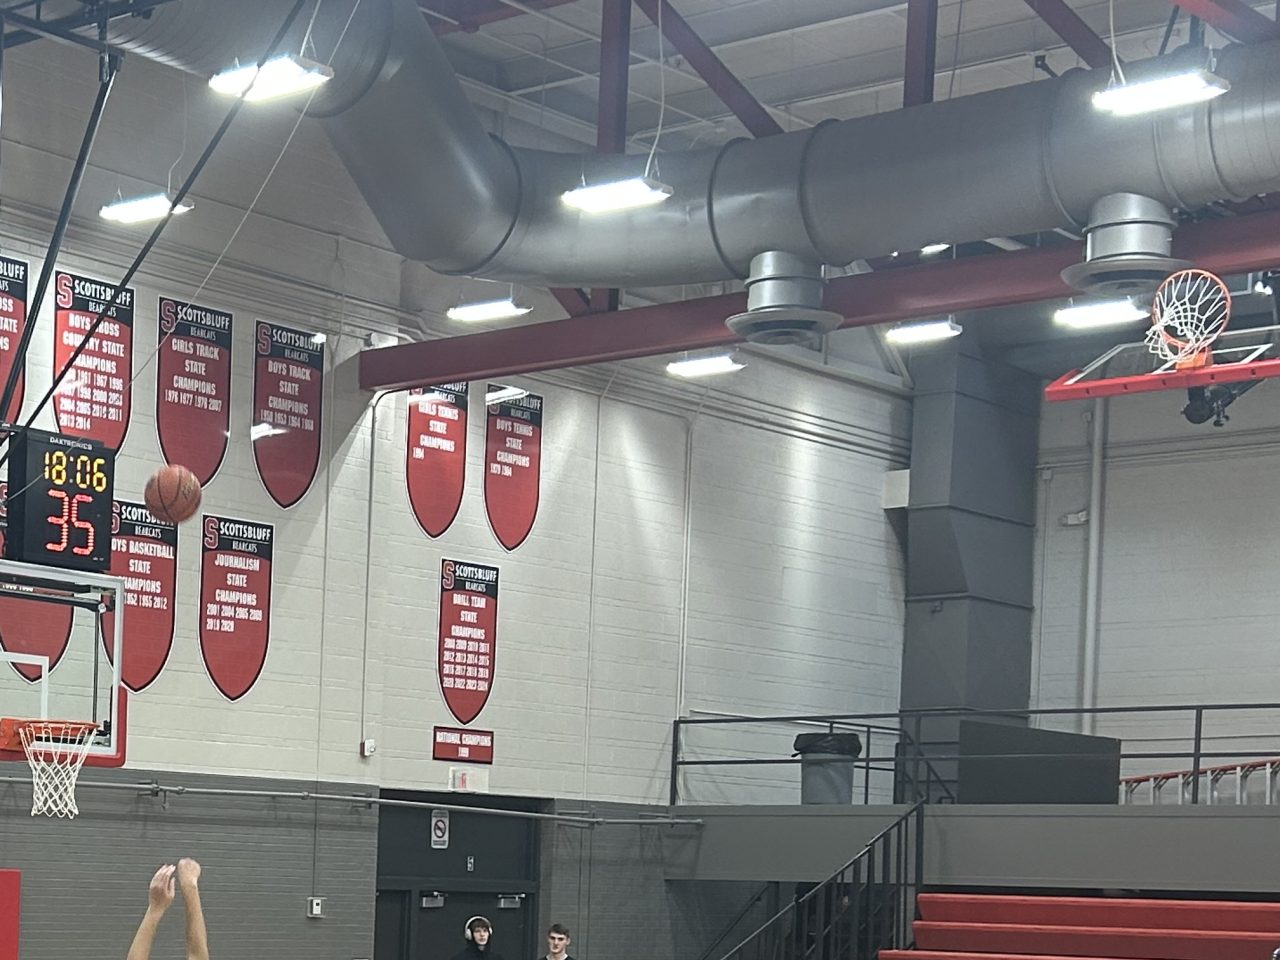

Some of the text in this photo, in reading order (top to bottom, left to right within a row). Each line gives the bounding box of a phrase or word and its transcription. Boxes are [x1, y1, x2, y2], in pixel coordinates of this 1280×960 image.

[68, 312, 91, 330] BOYS
[177, 305, 230, 330] SCOTTSBLUFF
[101, 339, 125, 358] STATE
[171, 338, 220, 361] GIRLS TRACK
[184, 359, 206, 376] STATE
[268, 360, 311, 381] BOYS TRACK
[173, 375, 216, 396] CHAMPIONS
[279, 380, 300, 396] STATE
[268, 396, 309, 416] CHAMPIONS
[505, 437, 522, 450] STATE
[44, 451, 107, 492] 18:06
[46, 489, 94, 555] 35
[219, 521, 271, 541] SCOTTSBLUFF
[134, 526, 162, 539] BEARCATS
[129, 540, 174, 559] BASKETBALL
[232, 541, 258, 553] BEARCATS
[128, 559, 151, 575] STATE
[214, 553, 260, 572] JOURNALISM
[226, 572, 248, 588] STATE
[455, 565, 497, 582] SCOTTSBLUFF
[215, 588, 257, 606] CHAMPIONS
